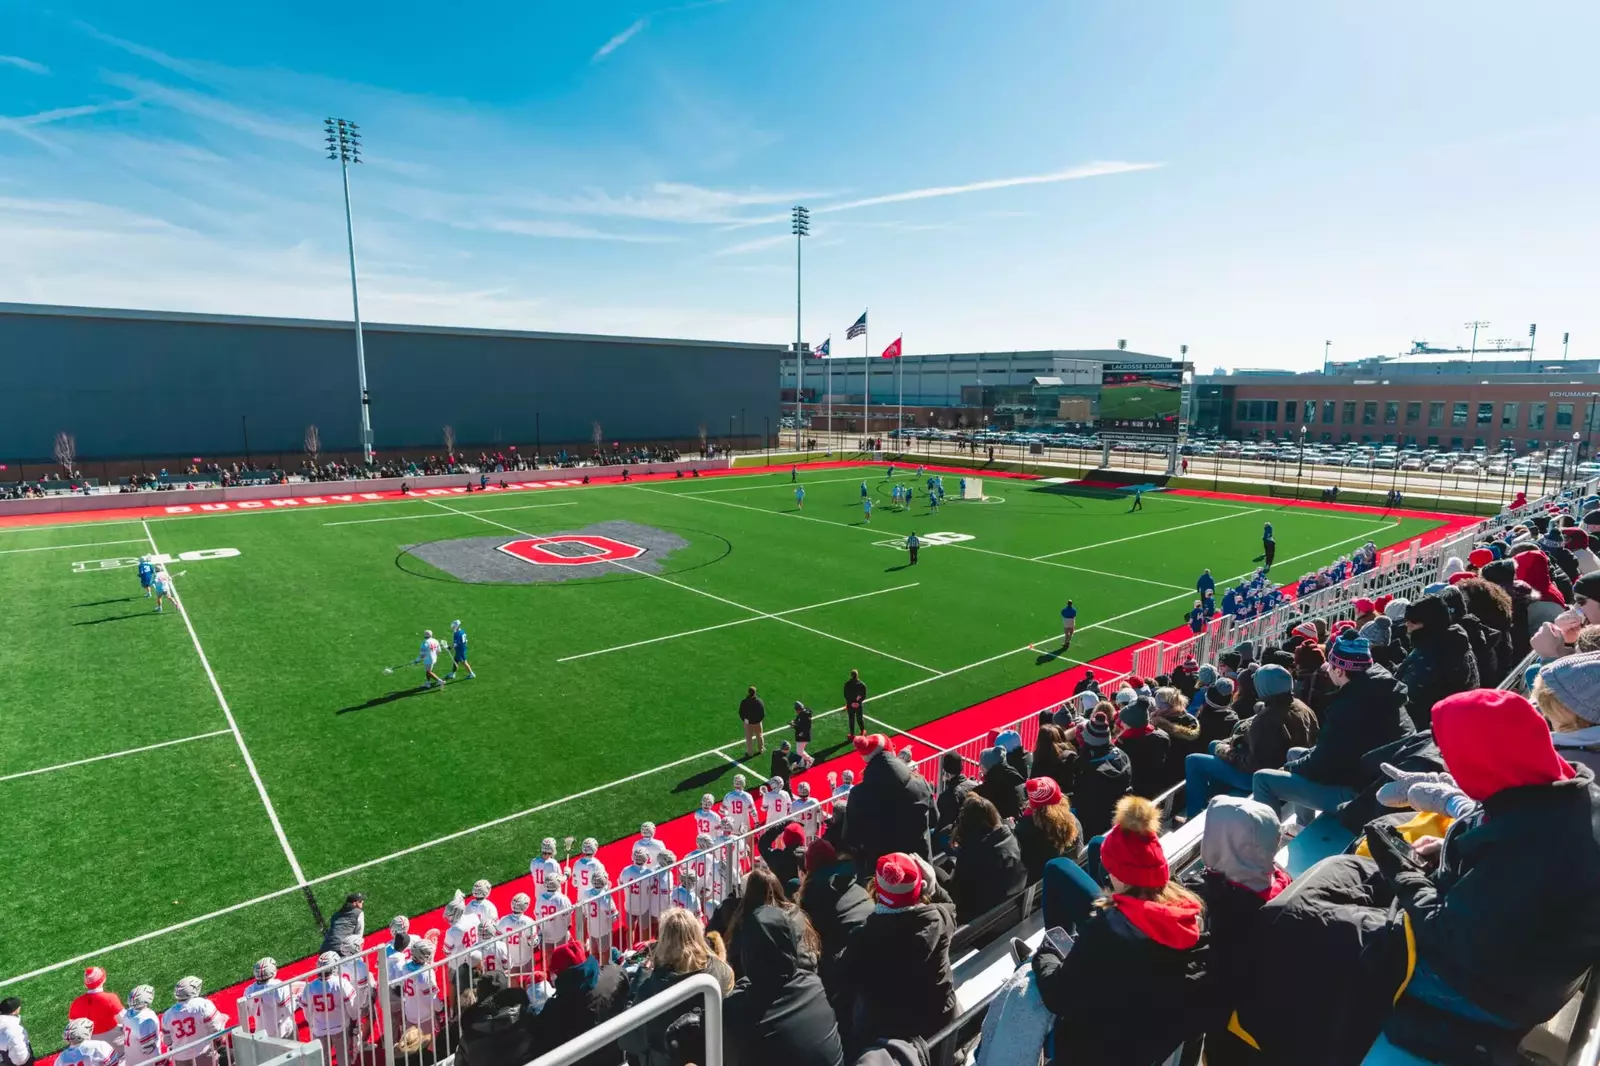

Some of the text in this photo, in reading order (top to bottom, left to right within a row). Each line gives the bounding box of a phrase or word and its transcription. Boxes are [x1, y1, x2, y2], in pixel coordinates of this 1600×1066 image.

[164, 492, 384, 514] BUCKEYE
[731, 800, 743, 814] 19
[775, 799, 782, 812] 6
[536, 869, 544, 884] 11
[581, 870, 589, 885] 5
[171, 1016, 196, 1039] 33
